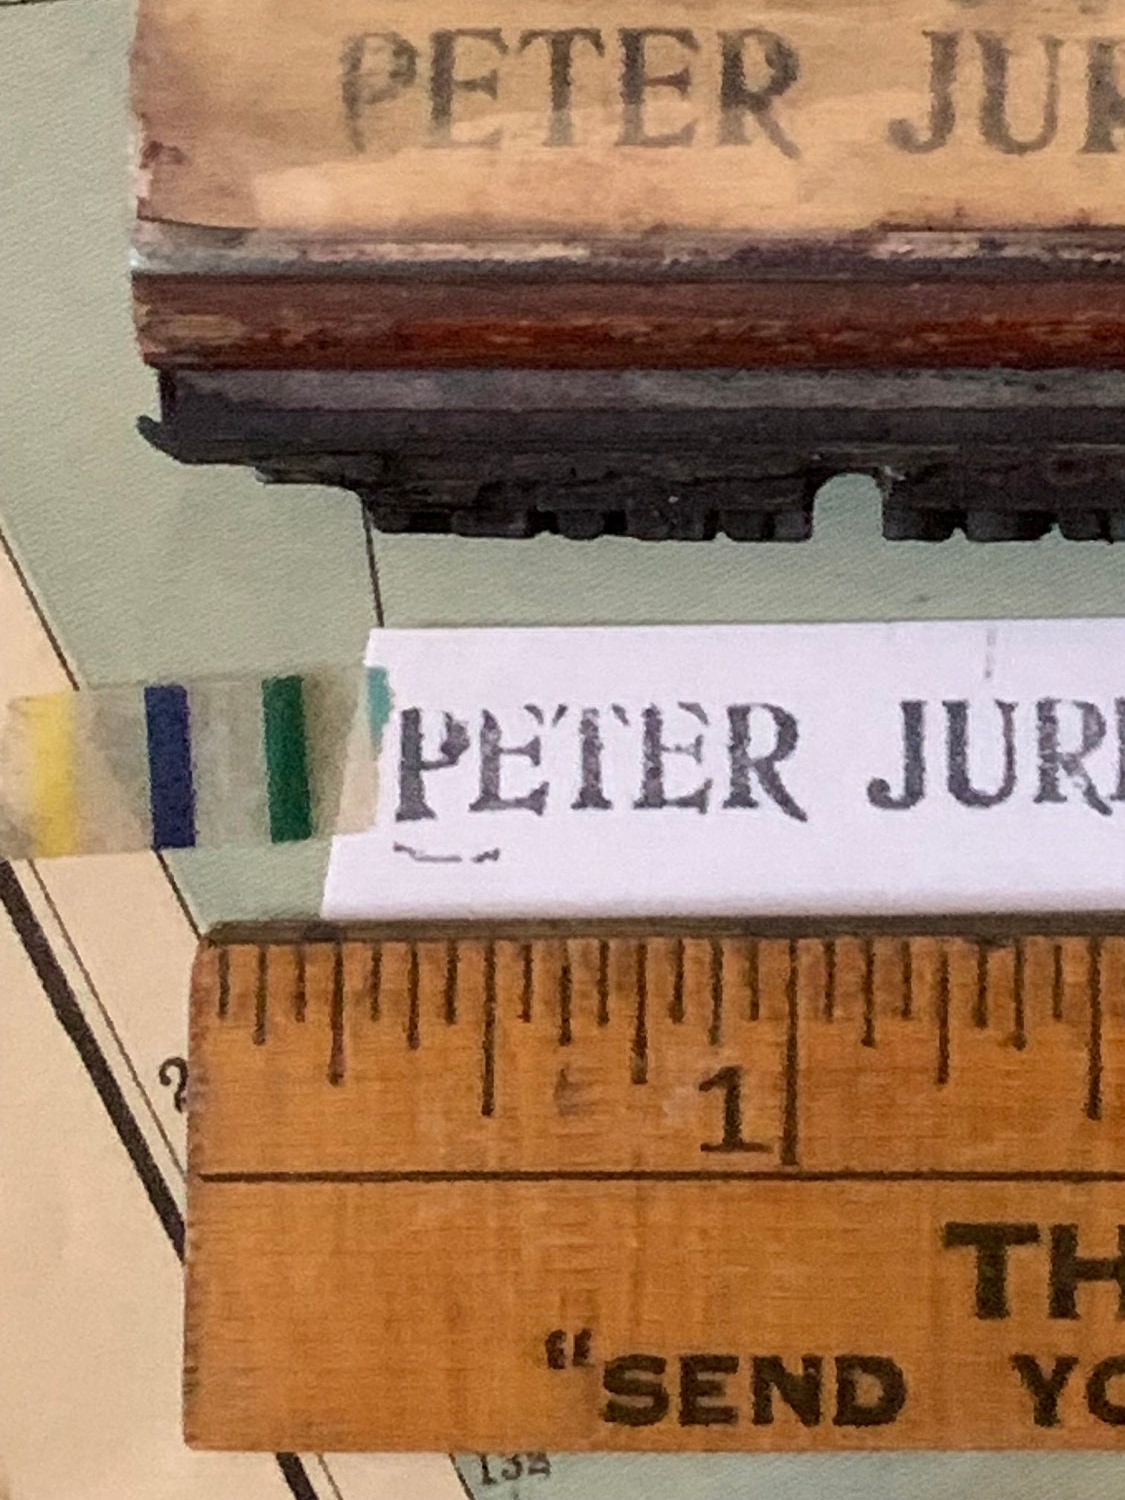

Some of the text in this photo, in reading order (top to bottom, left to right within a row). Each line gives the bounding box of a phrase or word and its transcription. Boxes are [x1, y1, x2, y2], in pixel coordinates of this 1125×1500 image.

[339, 27, 803, 160] PETER
[395, 699, 808, 822] PETER
[697, 1066, 773, 1154] 1
